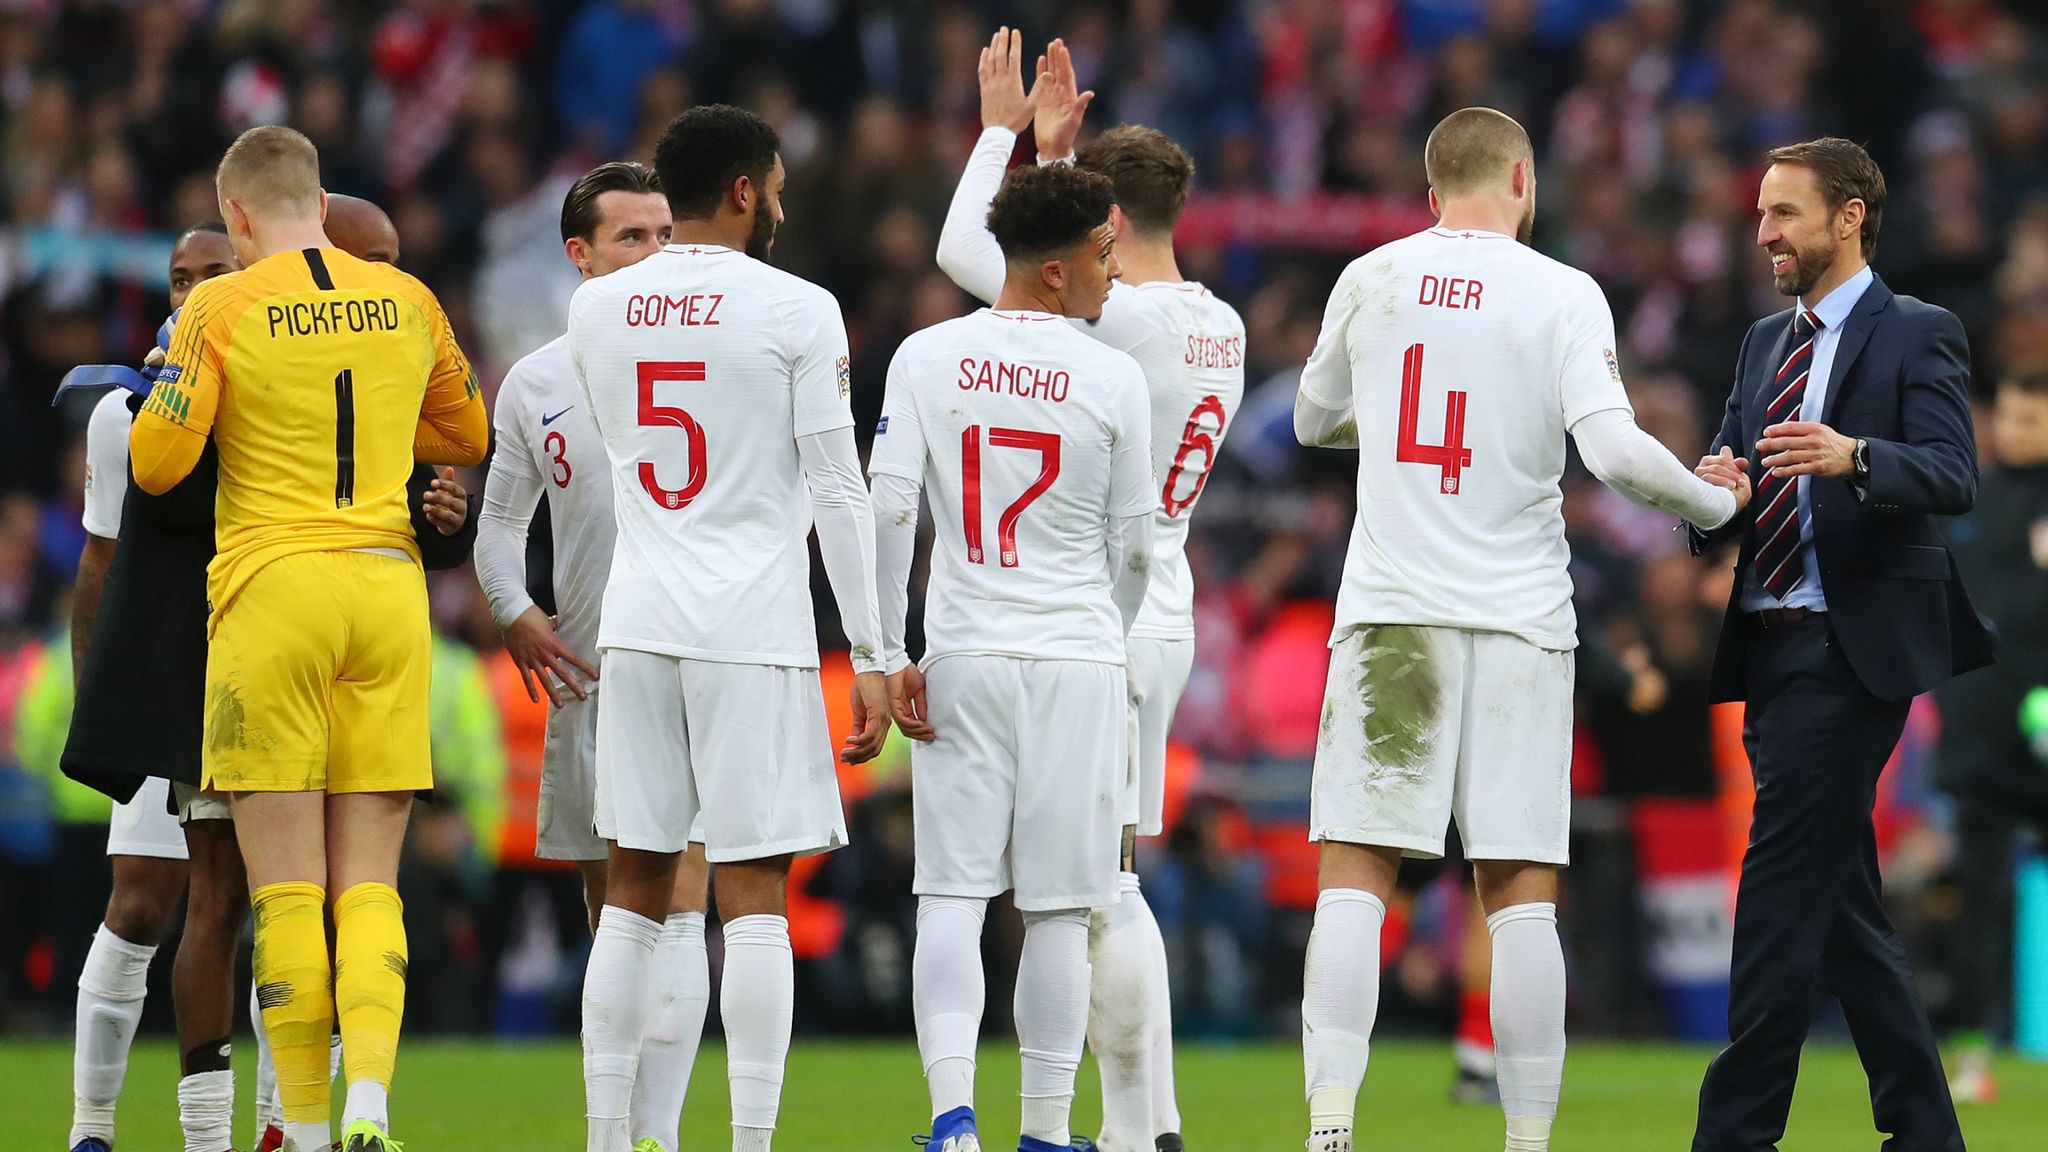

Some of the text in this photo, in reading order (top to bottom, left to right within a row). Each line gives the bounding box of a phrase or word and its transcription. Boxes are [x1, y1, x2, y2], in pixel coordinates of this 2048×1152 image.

[267, 298, 398, 338] PICKFORD
[626, 294, 724, 326] GOMEZ
[1418, 275, 1483, 310] DIER
[958, 358, 1069, 402] SANCHO
[1185, 335, 1241, 368] STONES
[334, 368, 354, 509] 1
[637, 361, 707, 510] 5
[1396, 343, 1472, 495] 4
[544, 431, 572, 488] 3
[1162, 395, 1226, 518] 6
[962, 425, 1061, 567] 17
